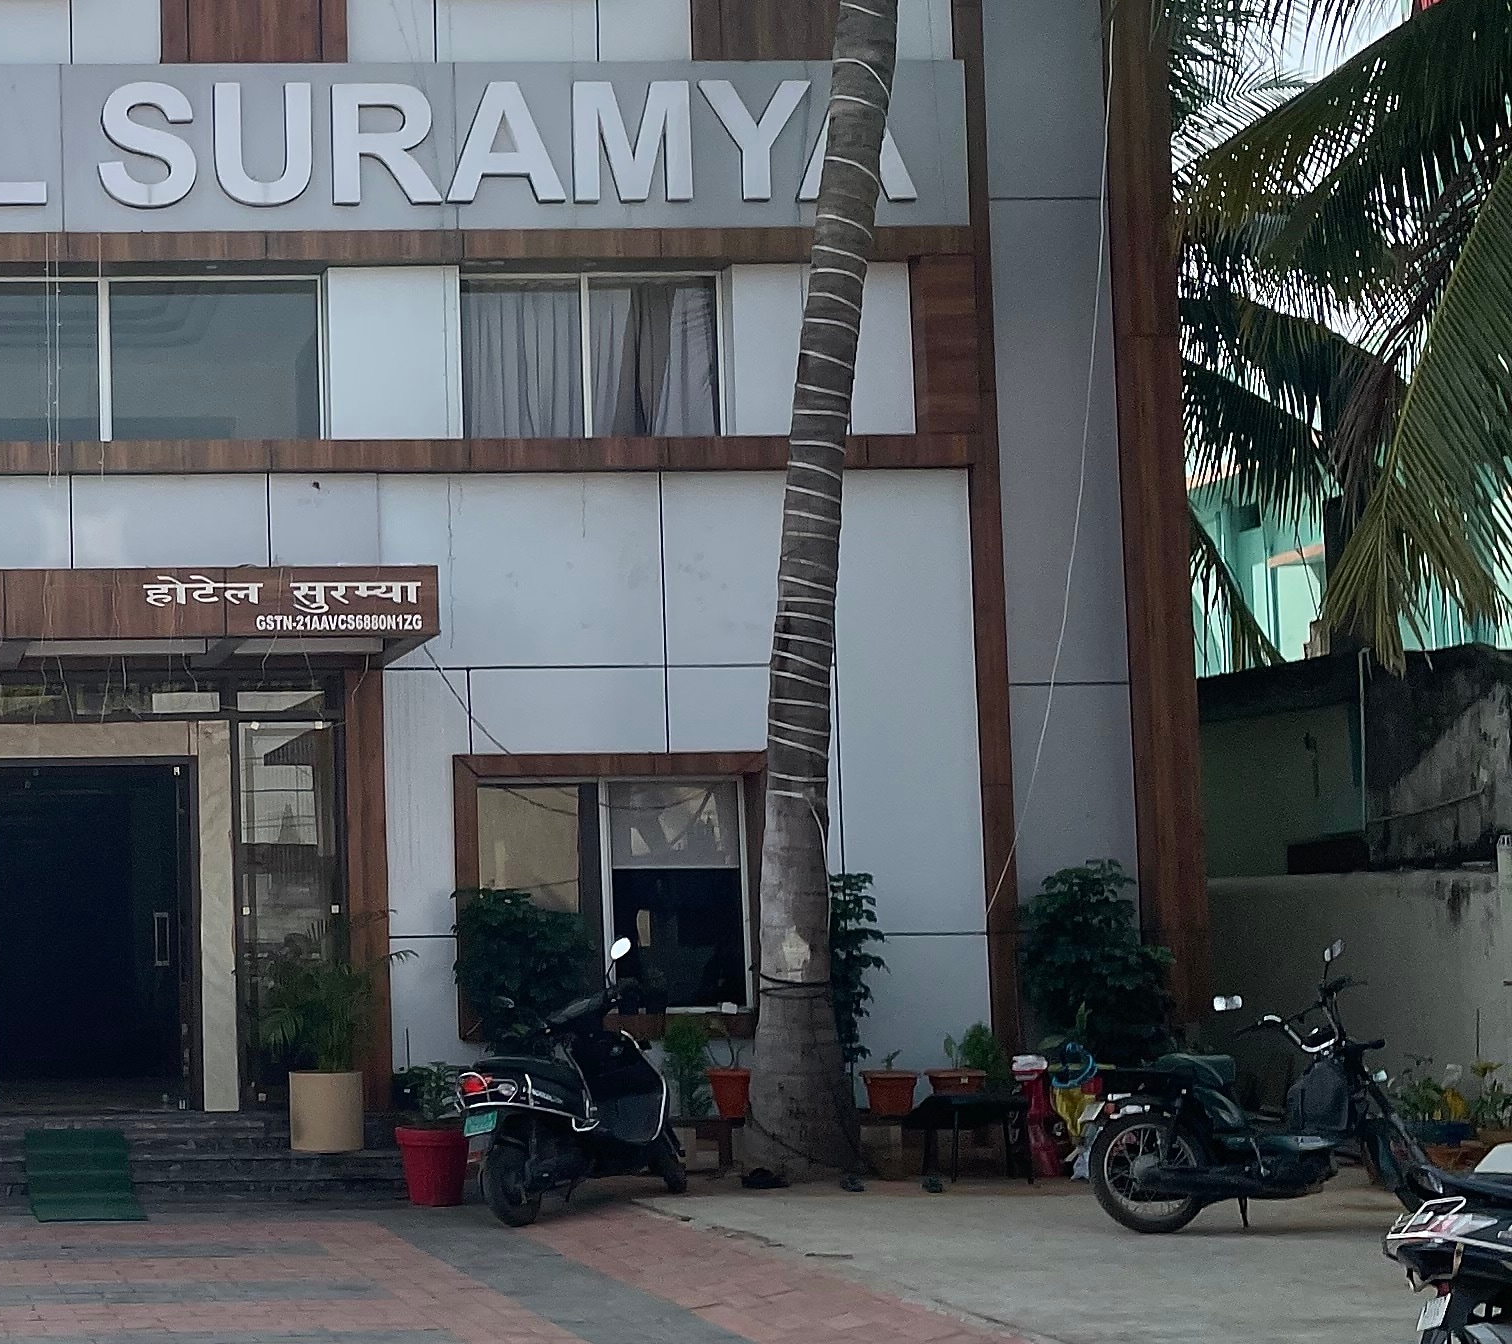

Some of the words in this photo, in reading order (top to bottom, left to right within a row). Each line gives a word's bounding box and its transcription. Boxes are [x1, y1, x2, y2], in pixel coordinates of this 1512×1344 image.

[142, 575, 264, 607] होटेल
[289, 580, 422, 613] सुरम्या
[255, 614, 423, 631] GSTN-21AAVCS6880N1ZG
